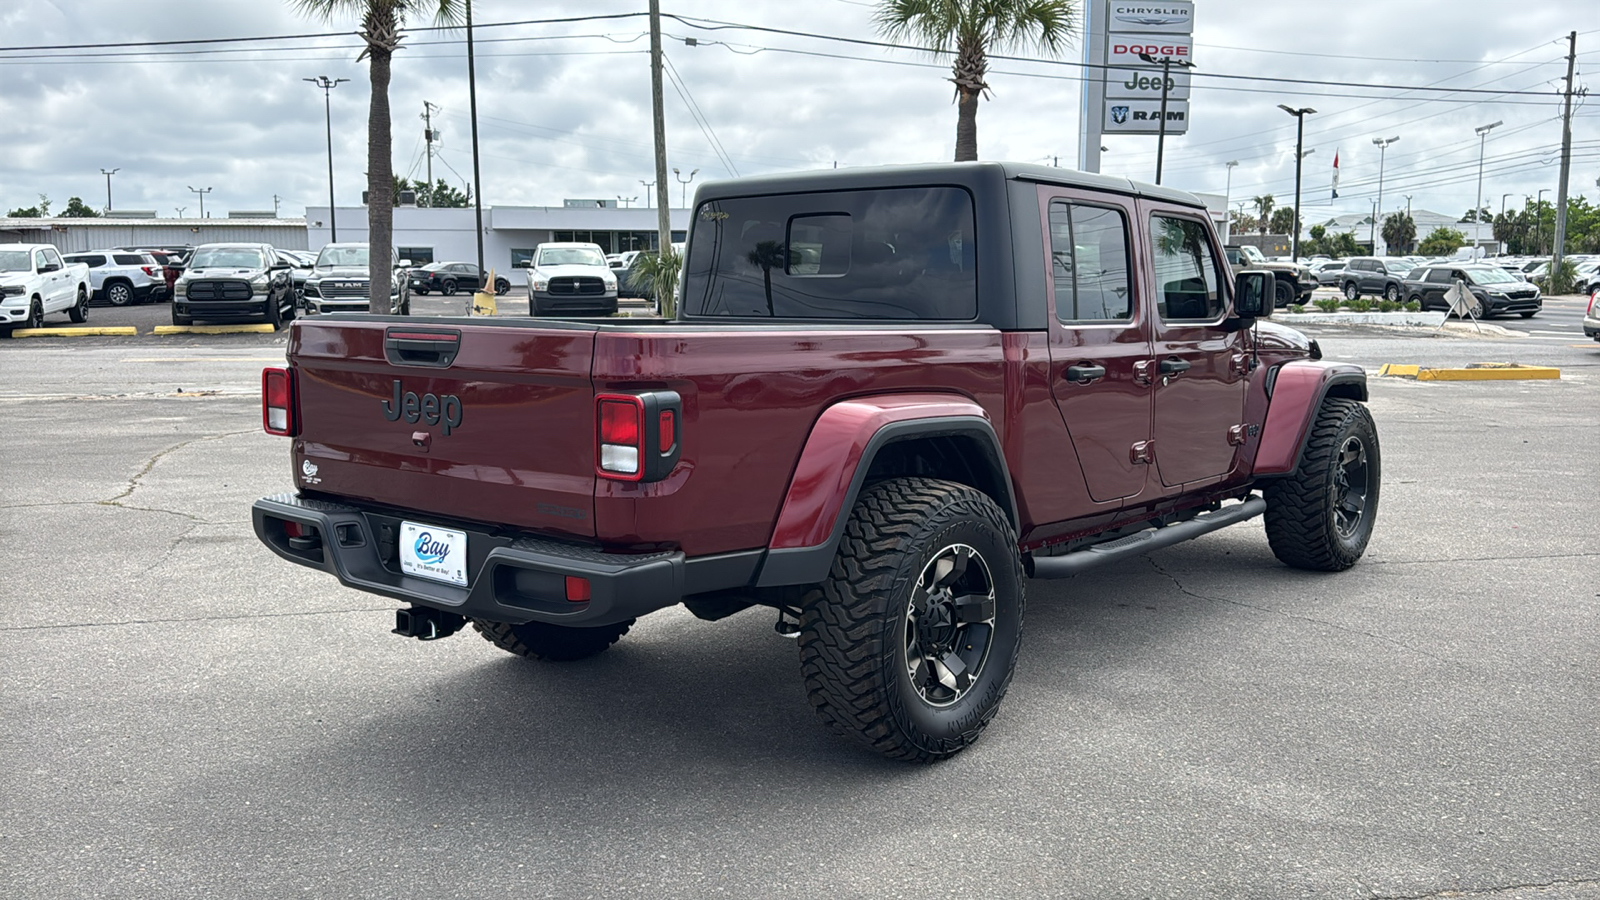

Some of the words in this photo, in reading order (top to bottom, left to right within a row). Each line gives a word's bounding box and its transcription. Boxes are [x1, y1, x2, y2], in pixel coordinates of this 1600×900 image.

[1116, 7, 1188, 15] CHRYSLER
[1113, 44, 1189, 56] DODGE
[1124, 71, 1175, 91] Jeep
[1132, 110, 1185, 121] RAM
[381, 379, 463, 436] Jeep
[416, 531, 451, 564] Bay
